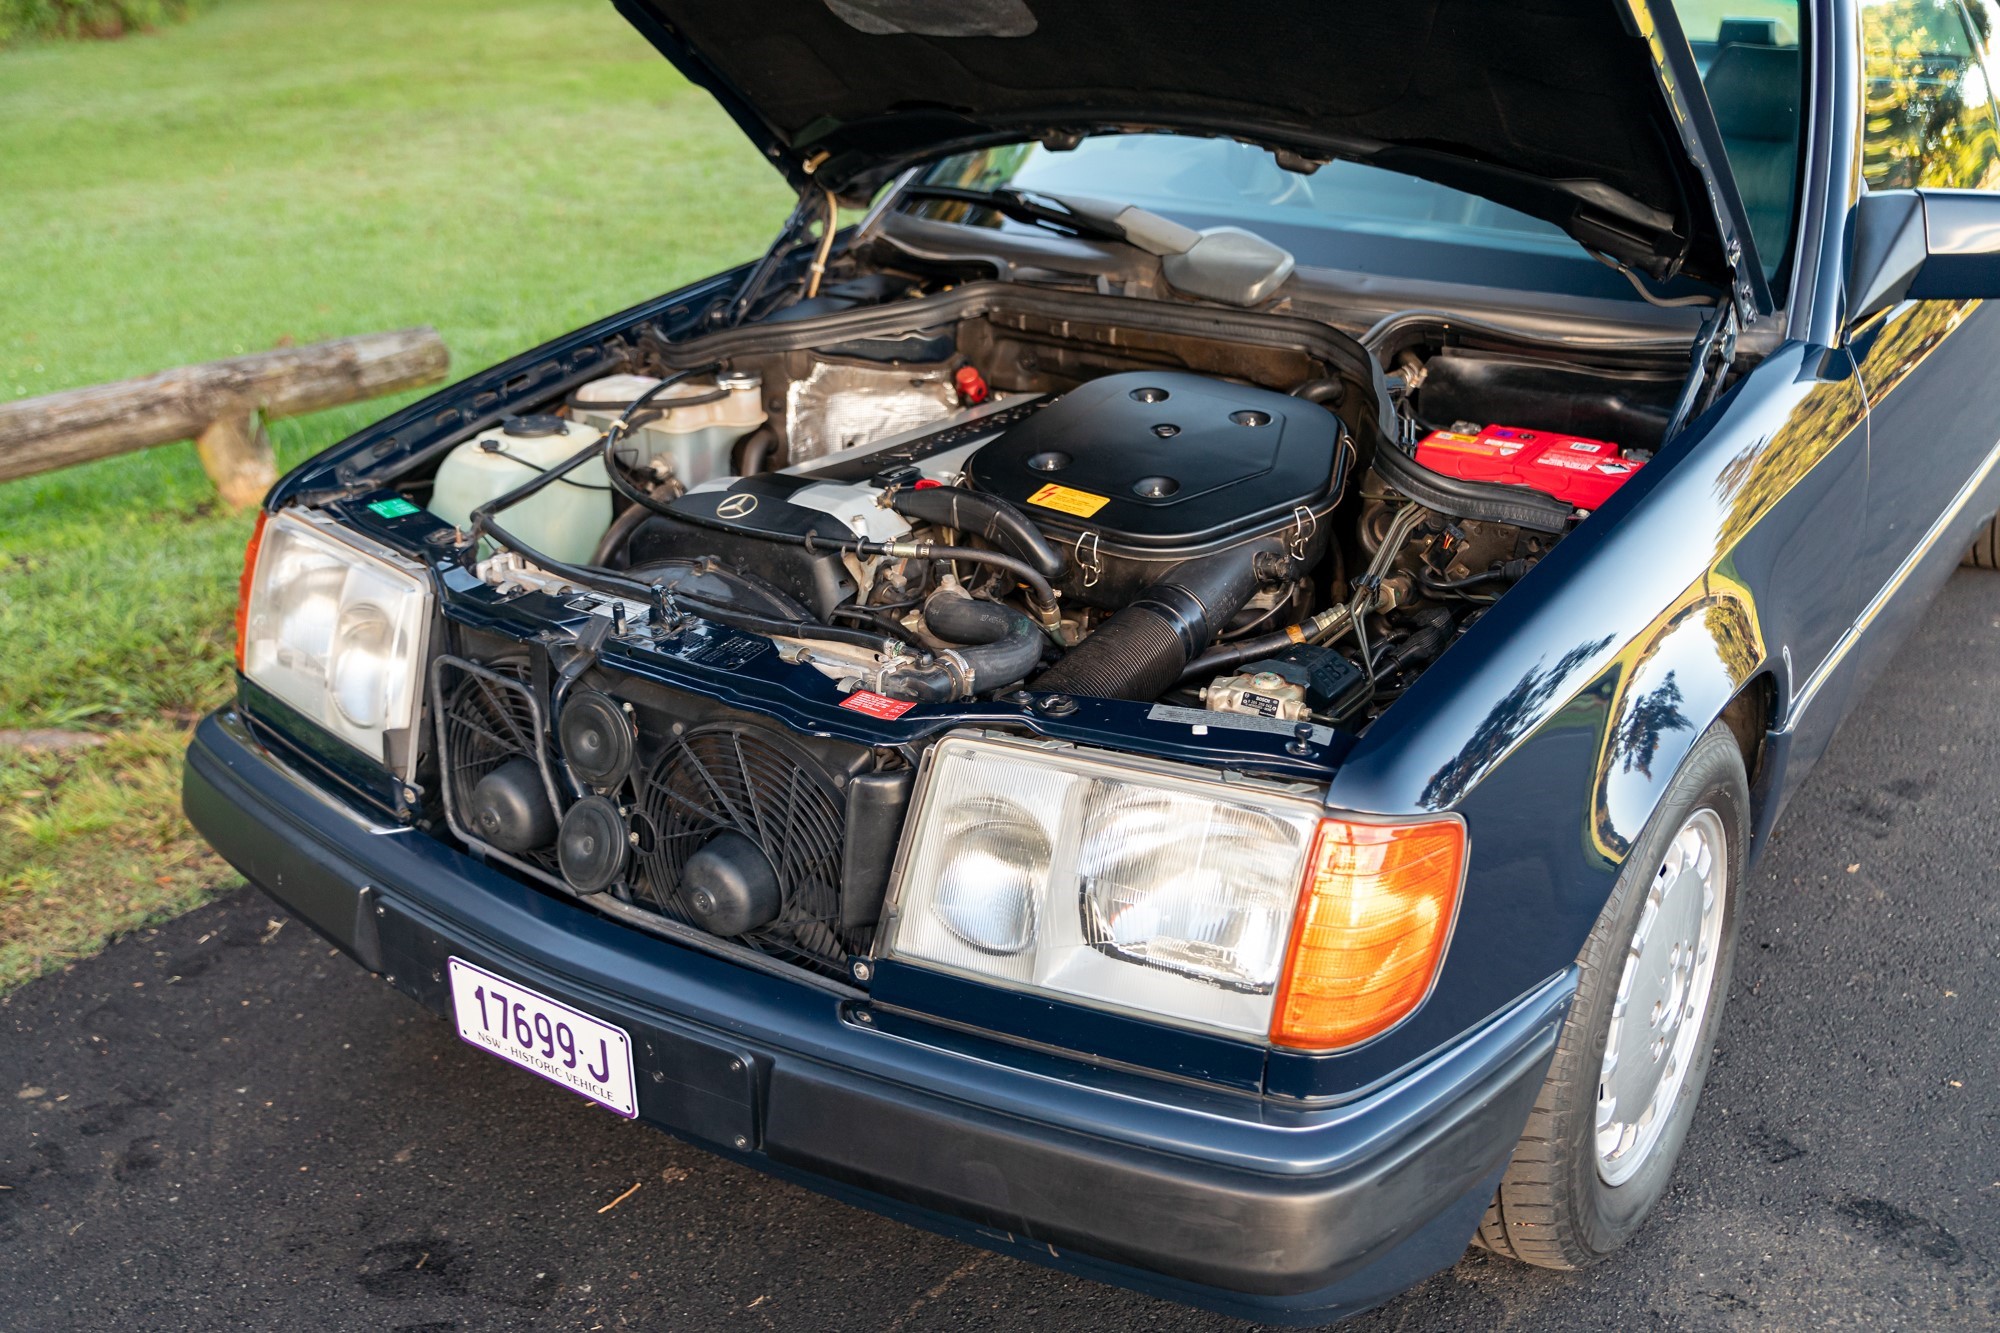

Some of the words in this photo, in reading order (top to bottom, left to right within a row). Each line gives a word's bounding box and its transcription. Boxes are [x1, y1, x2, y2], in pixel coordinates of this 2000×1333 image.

[1316, 657, 1349, 688] ABS
[1255, 696, 1271, 704] BOSCH
[475, 985, 577, 1069] 17699
[587, 1038, 610, 1083] J
[477, 1031, 502, 1049] NSW
[510, 1046, 563, 1078] HISTORIC
[565, 1071, 615, 1102] VEHICLE
